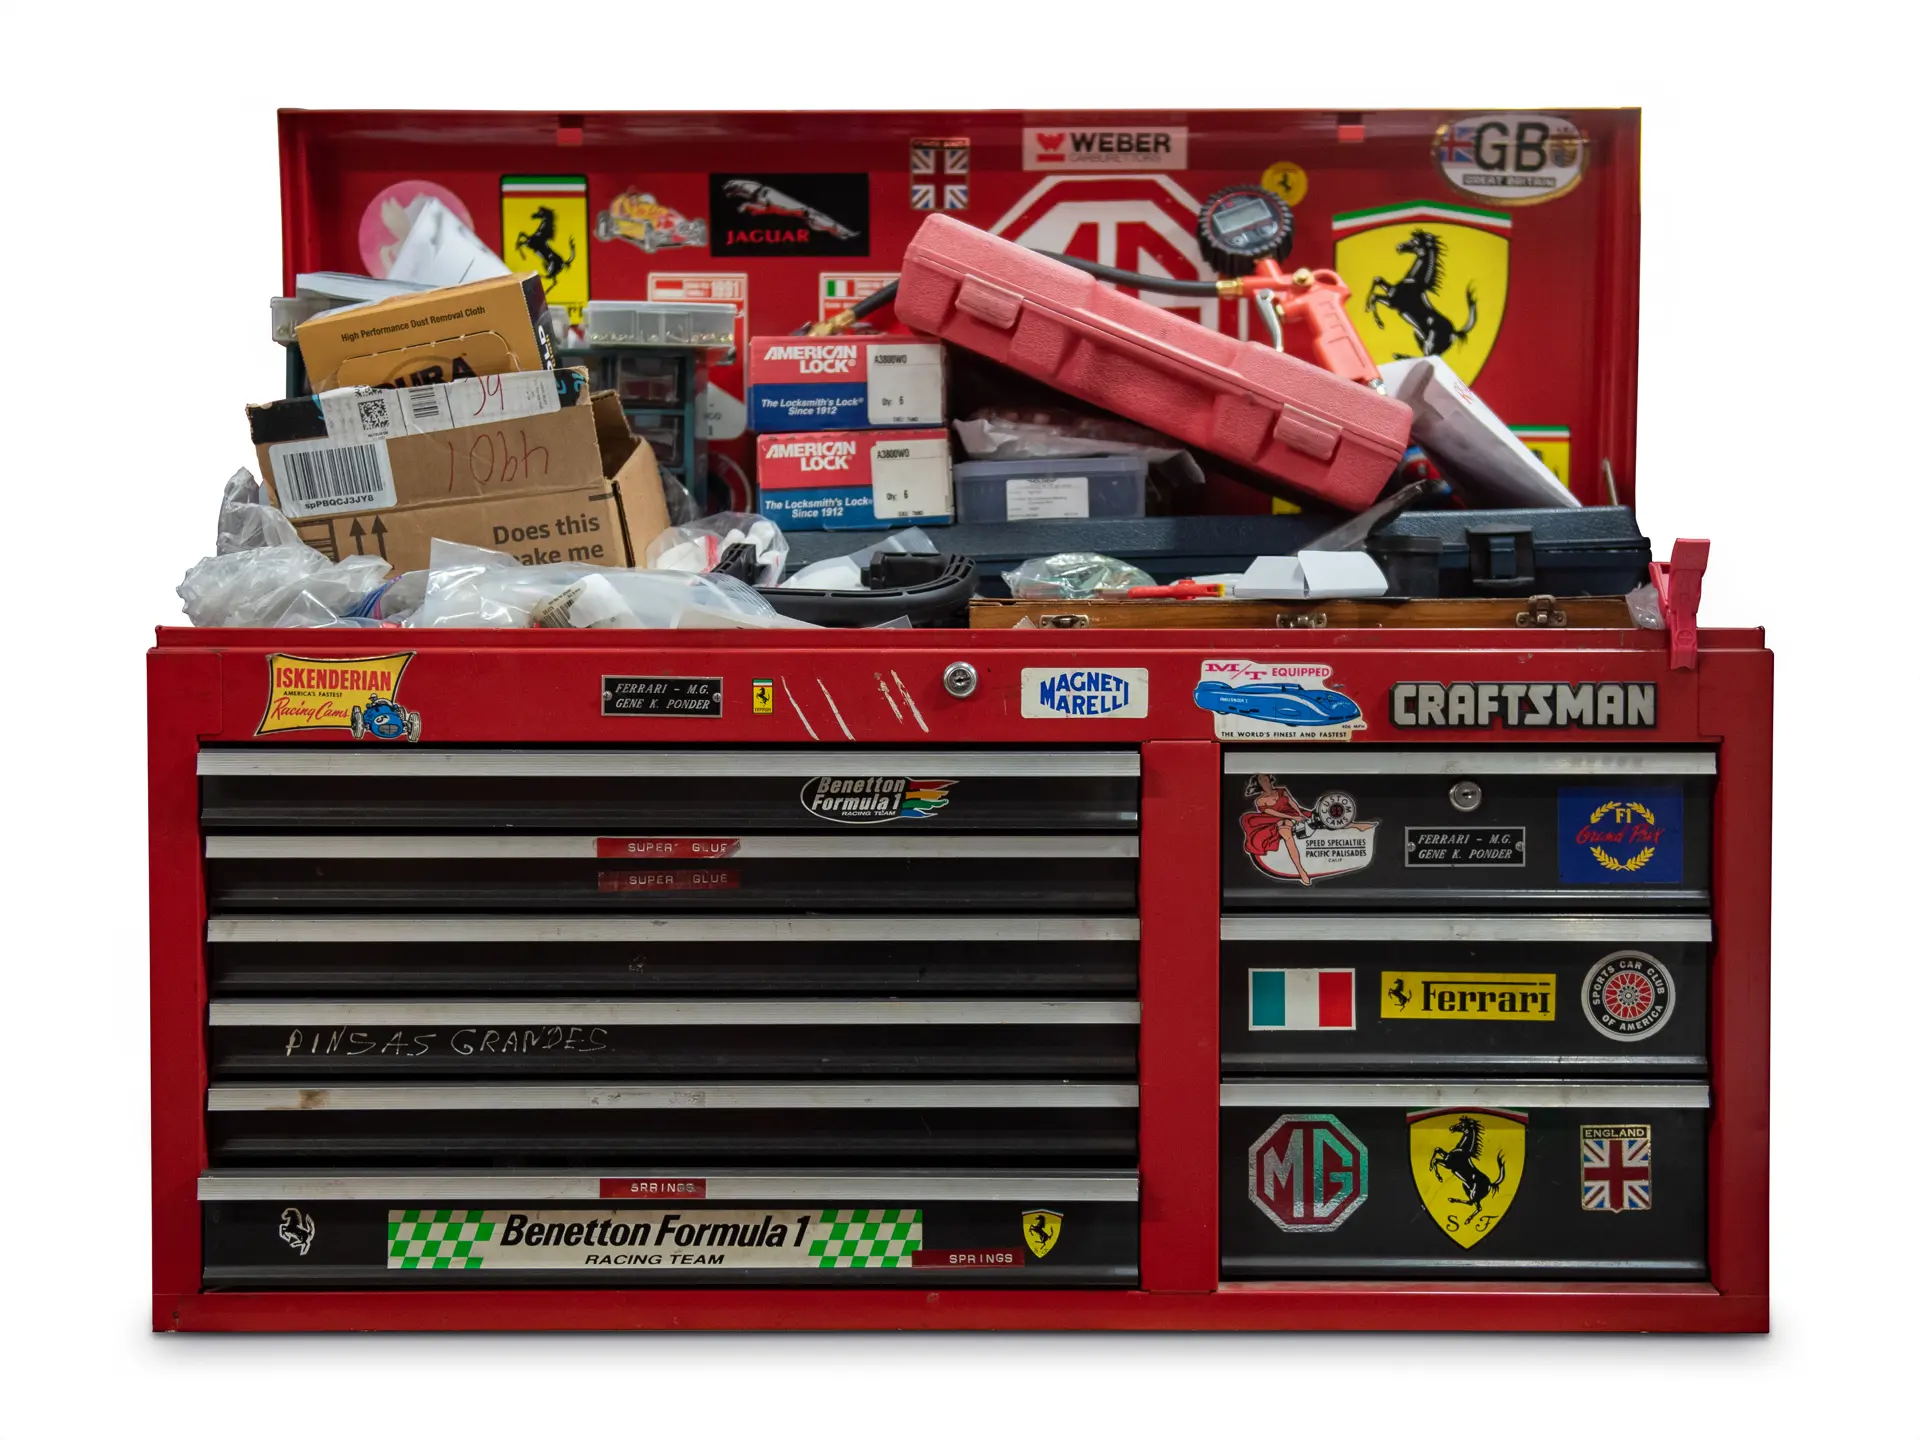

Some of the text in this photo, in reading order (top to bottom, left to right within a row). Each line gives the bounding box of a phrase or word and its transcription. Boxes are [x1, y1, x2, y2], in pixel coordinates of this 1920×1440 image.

[1070, 132, 1171, 153] WEBER
[1474, 121, 1549, 172] GB
[726, 229, 809, 246] JAGUAR
[341, 305, 486, 343] High Performance Dust Removal Cloth
[764, 345, 857, 361] AMERICAN
[762, 398, 778, 408] The
[779, 397, 833, 408] Locksmith's
[788, 406, 838, 416] Since 1912
[765, 441, 856, 460] AMERICAN
[801, 456, 849, 471] LOCK
[765, 500, 782, 510] The
[784, 499, 842, 509] Locksmith's
[791, 508, 844, 518] Since 1912
[493, 512, 601, 546] Does this
[512, 543, 604, 567] ake me
[276, 667, 392, 692] ISKENDERIAN
[1205, 663, 1330, 680] M/T EQUIPPED
[283, 690, 316, 698] AMERICA'S
[615, 683, 668, 694] FERRARI
[687, 684, 709, 695] M.G.
[1040, 671, 1129, 702] MAGNETI
[615, 698, 711, 710] GENE K. PONDER
[1040, 683, 1129, 715] MARELLI
[1390, 682, 1657, 728] CRAFTSMAN
[270, 697, 349, 722] Racing Cams
[816, 776, 906, 794] Benetton
[812, 793, 902, 811] Formula 1
[1321, 795, 1352, 814] CUSTOM
[1325, 816, 1348, 826] CAMS
[1615, 808, 1631, 823] F1
[1418, 834, 1471, 845] FERRARI
[1489, 834, 1511, 845] M.G.
[1576, 823, 1665, 845] Grand Prix
[628, 843, 673, 852] SUPER
[1306, 839, 1366, 847] SPEED SPECIALTIES
[1306, 850, 1330, 858] PACIFIC
[1418, 849, 1513, 859] GENE K. PONDER
[629, 874, 728, 885] SUPER GLUE
[1592, 960, 1665, 1005] SPORTS CAR CLUB
[1421, 980, 1551, 1014] Ferrari
[1602, 1005, 1663, 1031] OF AMERICA
[450, 1026, 608, 1056] GRANDES
[1585, 1127, 1645, 1138] ENGLAND
[1264, 1128, 1353, 1218] MG
[500, 1213, 811, 1246] Benetton Formula 1
[1445, 1214, 1460, 1233] S
[585, 1254, 725, 1265] RACING TEAM
[949, 1253, 1014, 1264] SPRINGS
